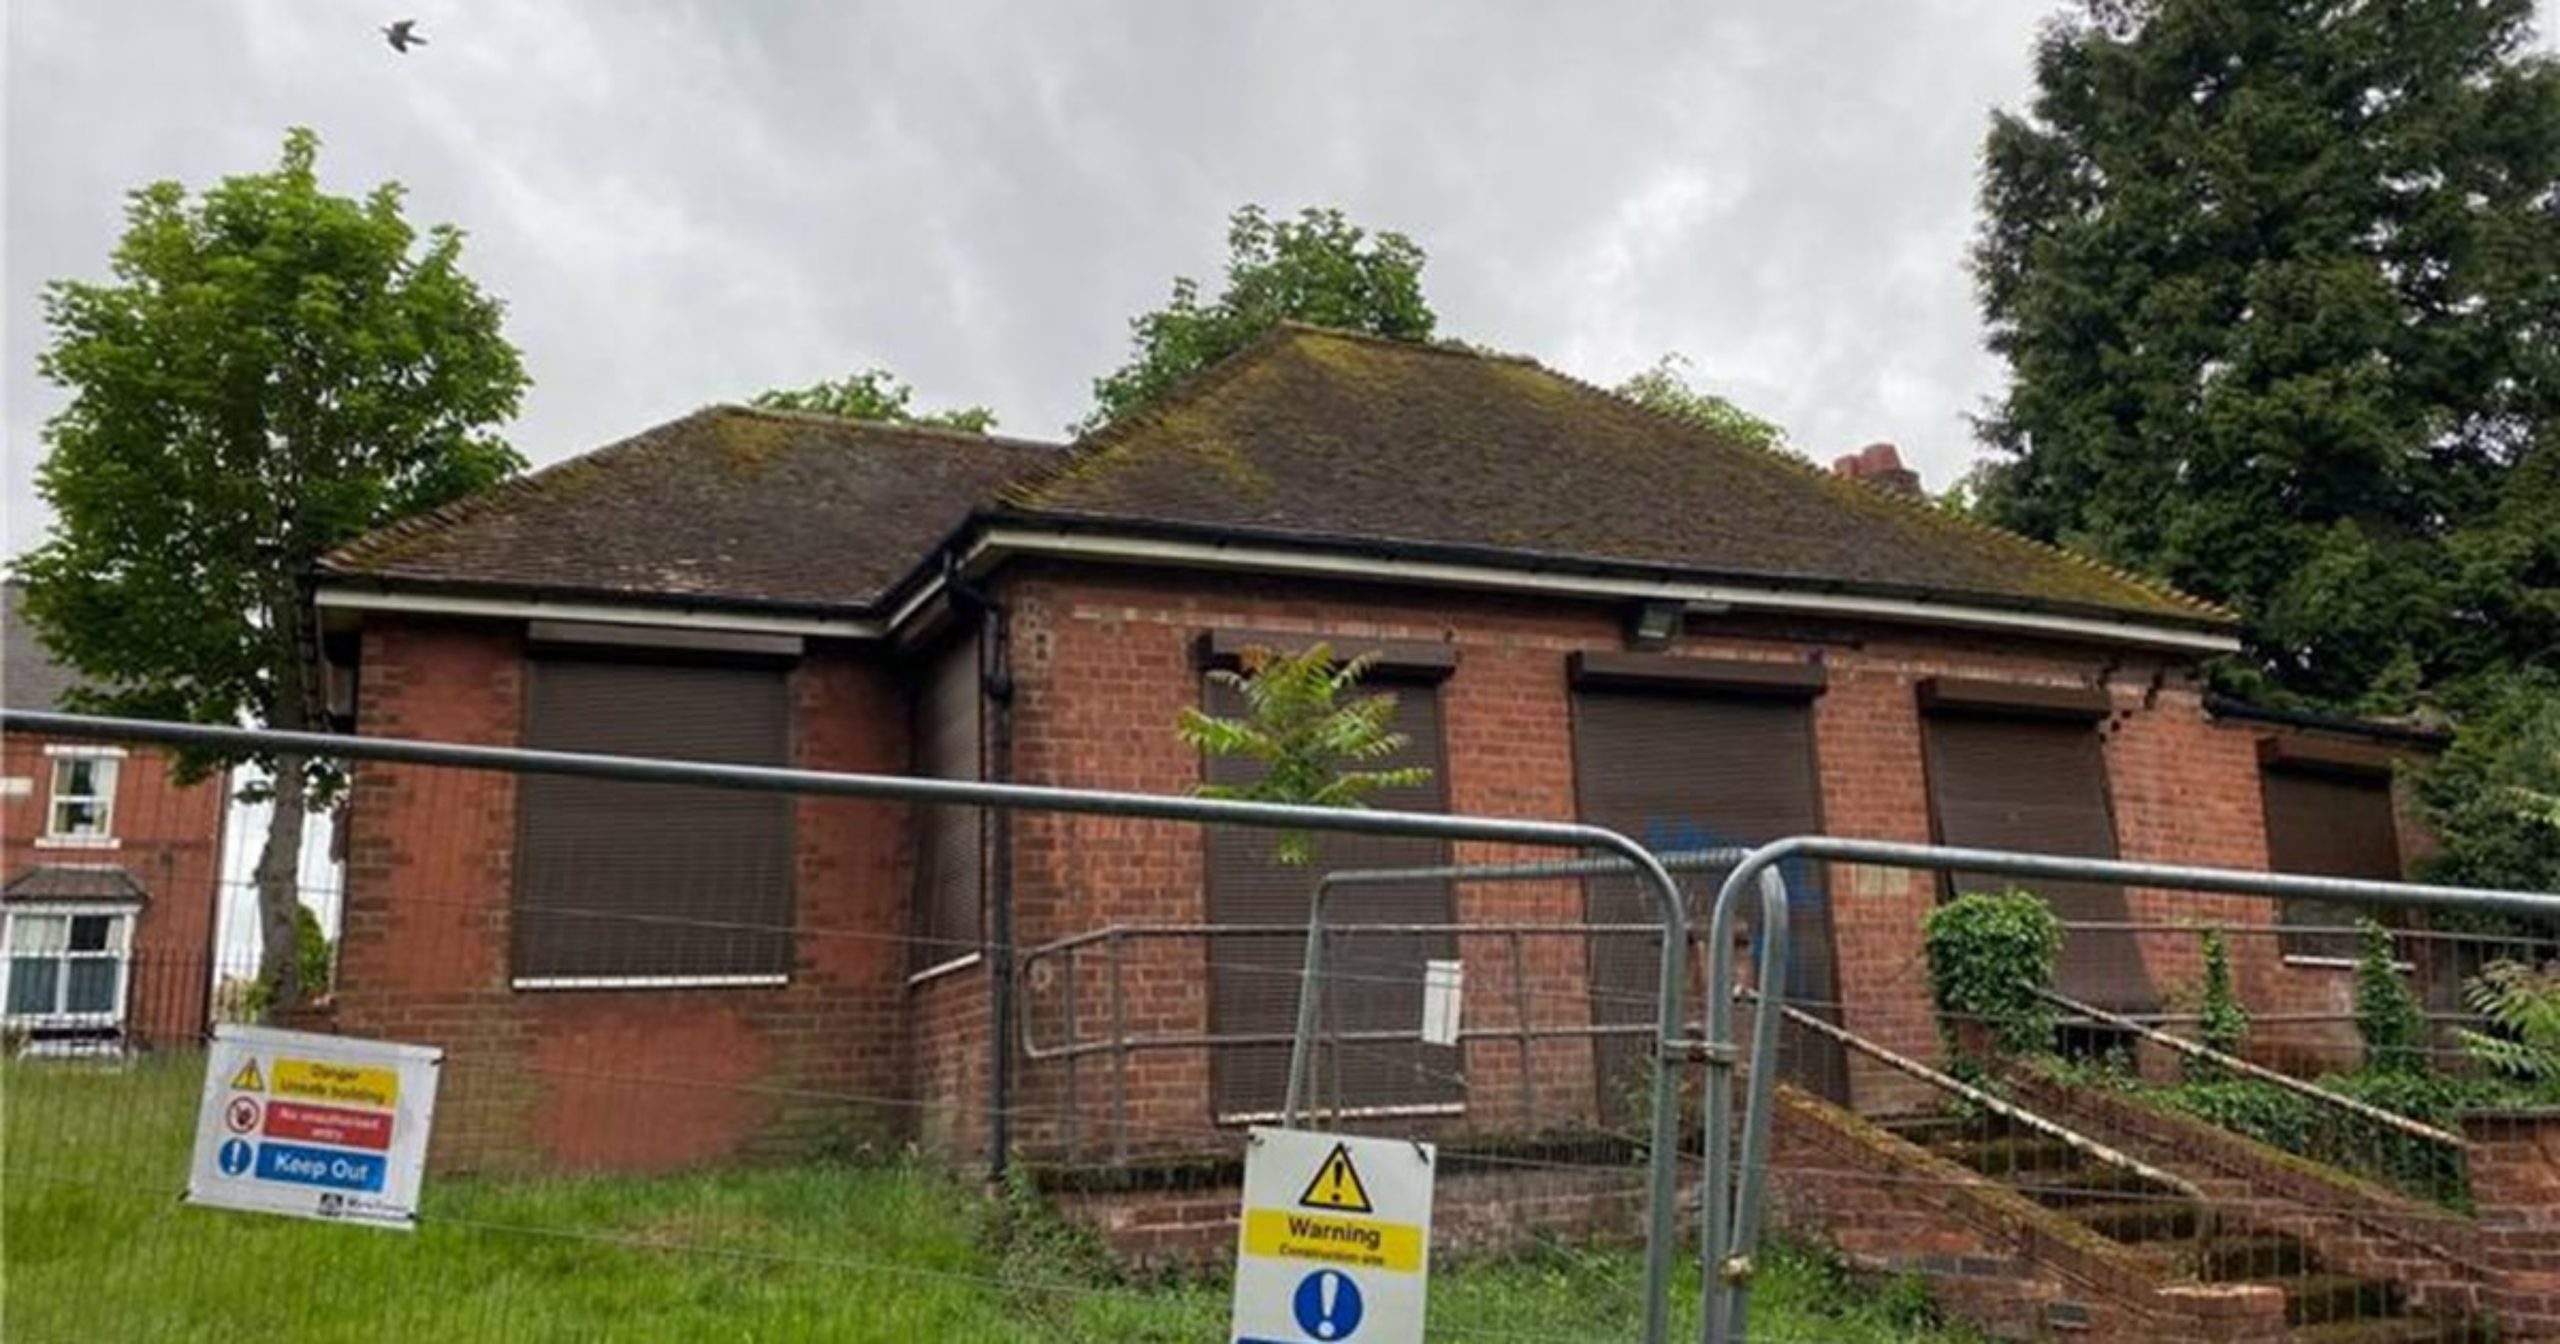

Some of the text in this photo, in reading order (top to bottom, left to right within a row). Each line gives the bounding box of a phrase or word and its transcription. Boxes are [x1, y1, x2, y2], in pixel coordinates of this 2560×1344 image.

[310, 1063, 360, 1082] Danger
[273, 1151, 369, 1181] Keep Out
[1287, 1214, 1381, 1251] Warning
[1279, 1242, 1359, 1263] Construction
